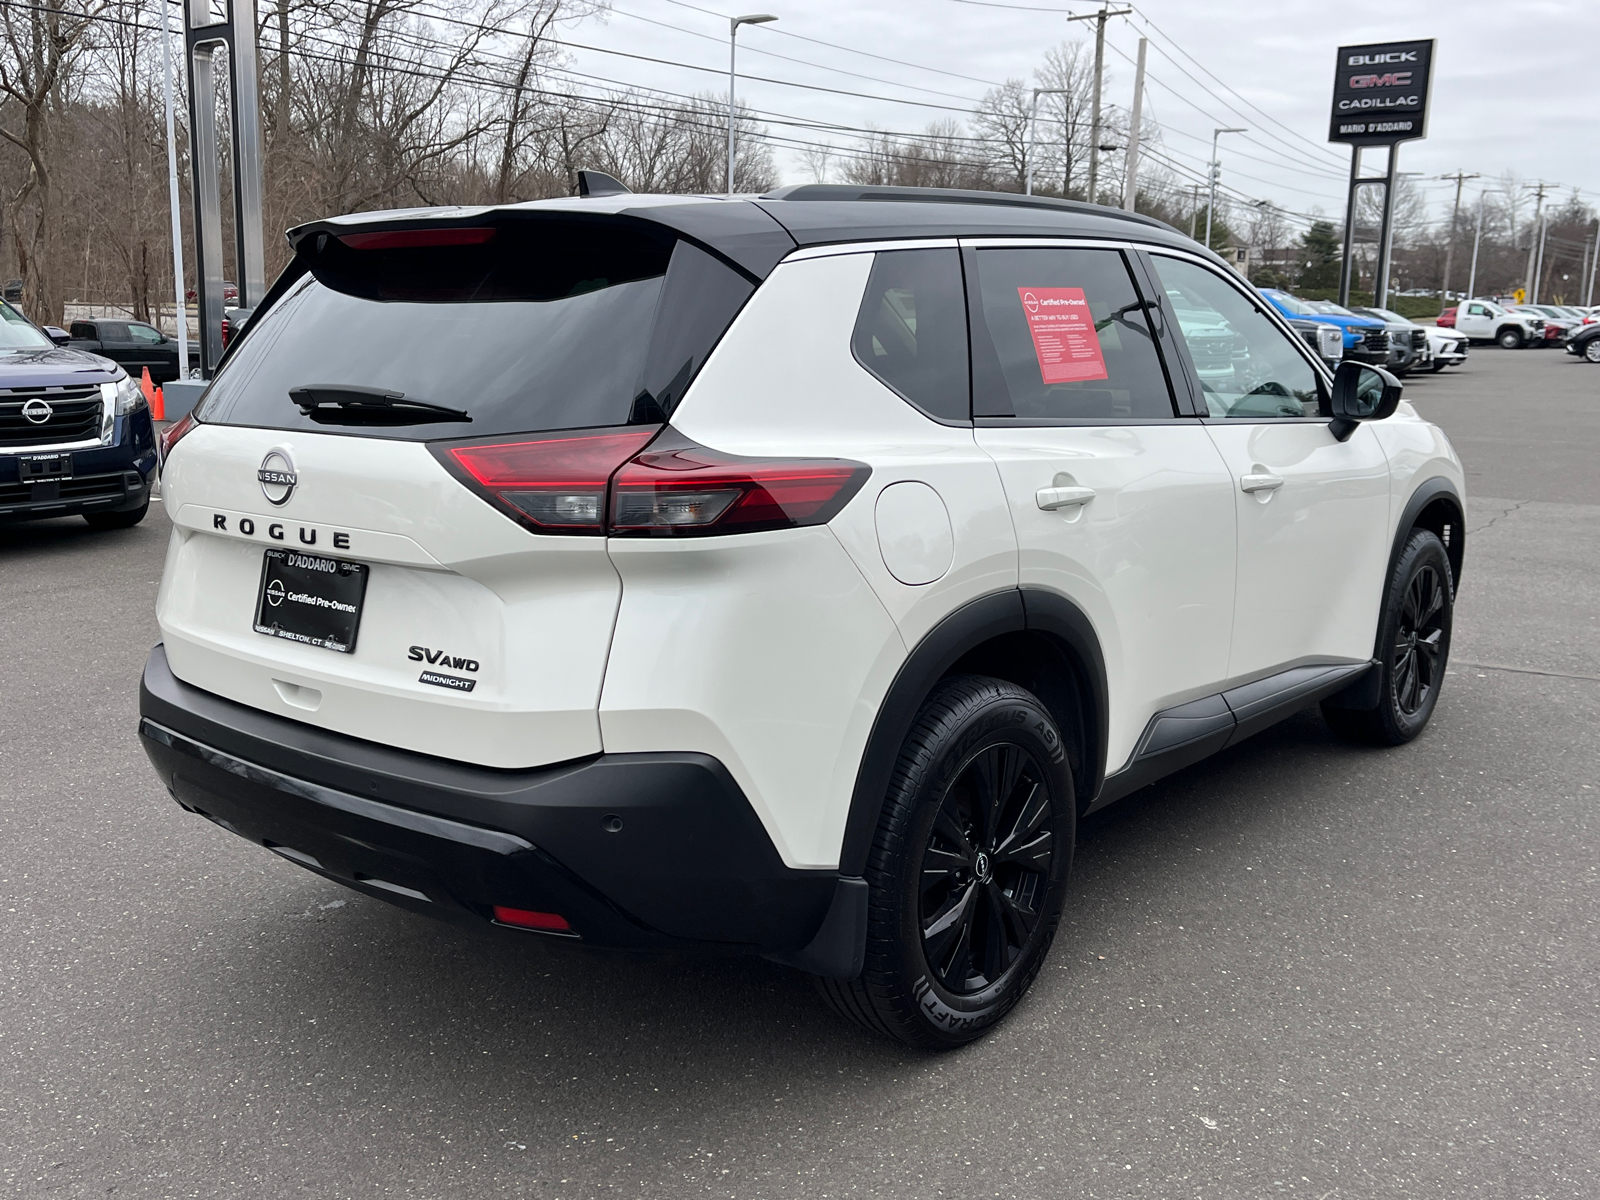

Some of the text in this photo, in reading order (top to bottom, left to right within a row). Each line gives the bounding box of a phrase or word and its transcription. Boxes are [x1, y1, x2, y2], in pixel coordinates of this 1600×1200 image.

[1348, 51, 1418, 66] BUICK
[1349, 71, 1413, 89] GMC
[1338, 95, 1419, 110] CADILLAC
[1339, 121, 1413, 134] MARIO D'ADDARIO
[257, 471, 296, 484] NISSAN
[213, 513, 350, 549] ROGUE
[267, 550, 286, 559] BUICK
[288, 554, 337, 573] D'ADDARIO
[341, 563, 360, 572] GMC
[267, 589, 285, 597] NISSAN
[287, 591, 316, 605] Certified
[255, 625, 275, 635] NISSAN
[278, 630, 311, 644] SHELTON,
[312, 638, 323, 646] CT
[407, 645, 480, 672] SV AWD
[421, 673, 471, 688] MIDNIGHT
[1033, 720, 1057, 745] AS
